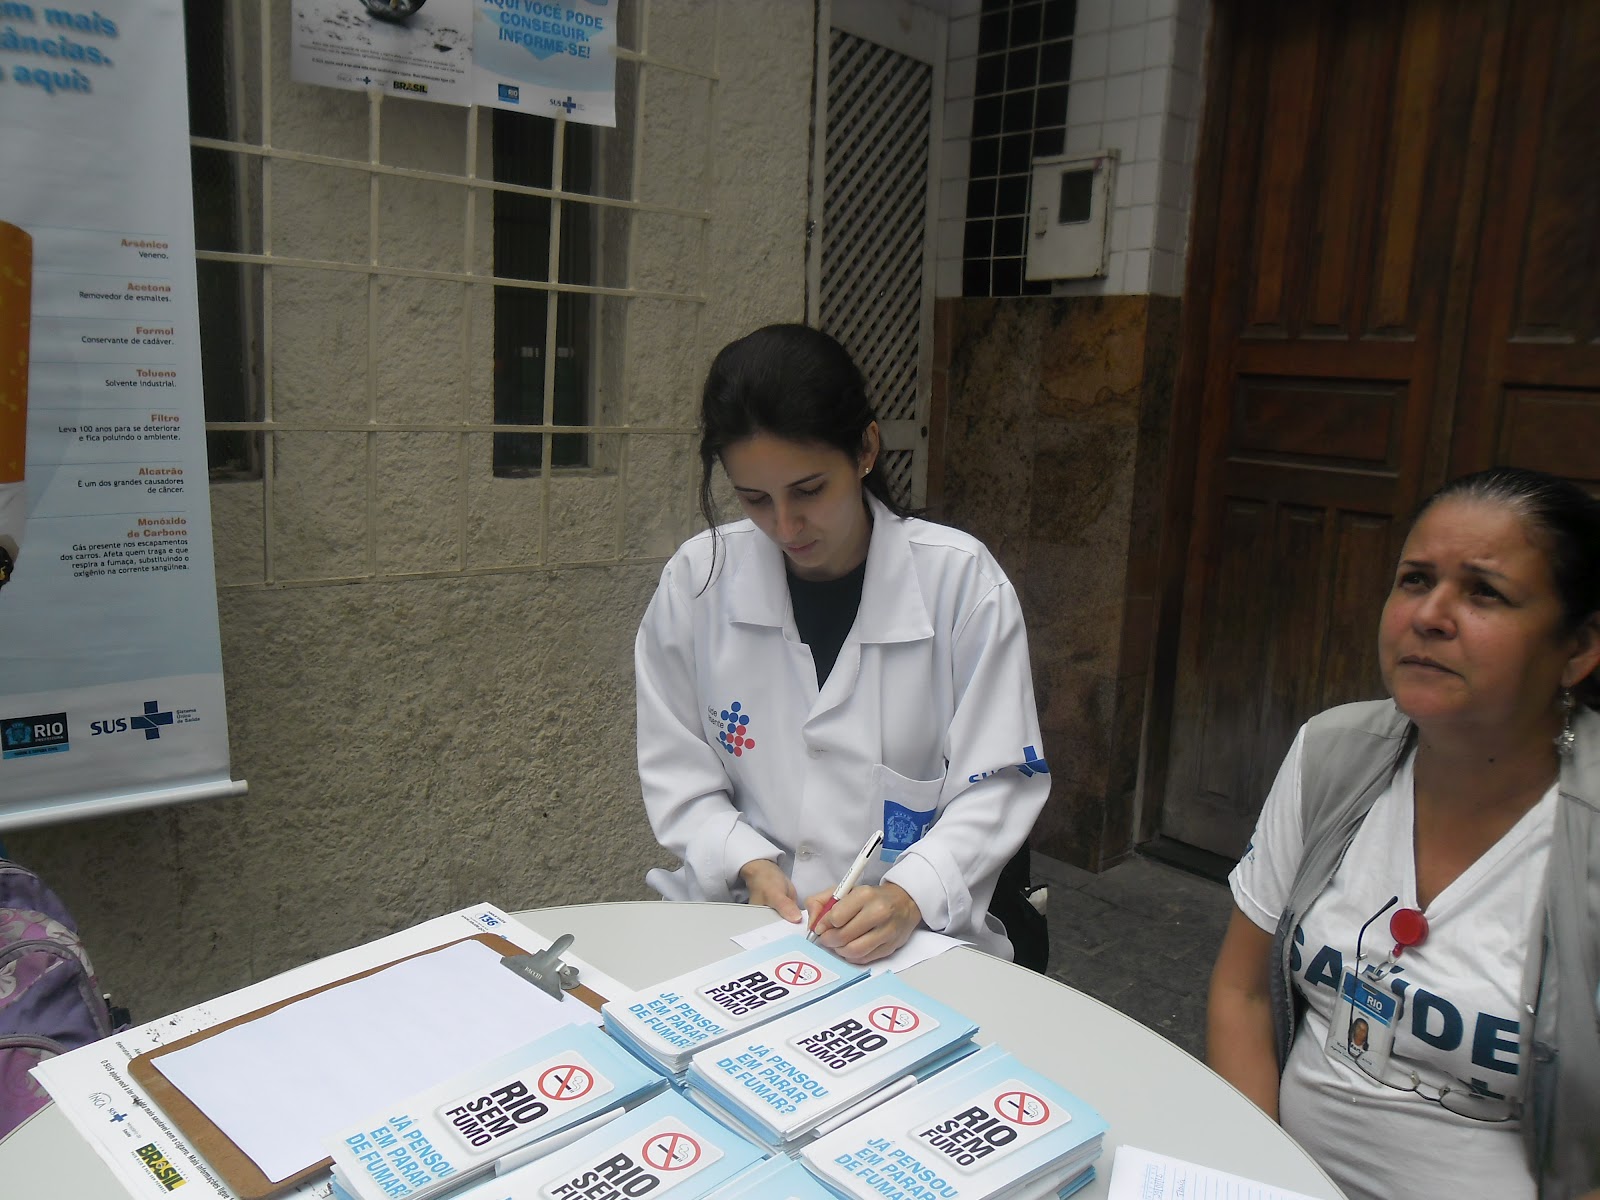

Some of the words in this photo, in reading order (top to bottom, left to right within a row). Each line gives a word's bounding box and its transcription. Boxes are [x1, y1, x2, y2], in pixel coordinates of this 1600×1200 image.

[44, 8, 118, 38] mais
[500, 11, 589, 42] CONSEGUIR.
[565, 10, 604, 30] PODE
[498, 28, 591, 59] INFORME-SE!
[393, 80, 428, 93] BRASIL
[121, 238, 168, 249] Arsênico
[139, 251, 169, 259] Veneno.
[79, 292, 121, 300] Removedor
[124, 293, 134, 301] de
[136, 294, 171, 302] esmaltes.
[127, 283, 171, 292] Acetona
[81, 336, 128, 344] Conservante
[131, 337, 141, 345] de
[142, 337, 174, 345] cadáver.
[136, 327, 174, 336] Formol
[136, 369, 176, 378] Tolueno
[151, 414, 179, 422] Filtro
[102, 434, 135, 443] poluindo
[99, 479, 111, 487] dos
[114, 479, 142, 488] grandes
[138, 467, 183, 476] Alcatrão
[147, 486, 157, 494] de
[127, 530, 140, 538] de
[143, 529, 187, 537] Carbono
[138, 517, 186, 526] Monóxido
[60, 553, 74, 561] dos
[75, 552, 101, 560] carros.
[103, 550, 123, 558] Afeta
[125, 549, 146, 558] quem
[148, 547, 167, 556] traga
[175, 547, 189, 555] que
[72, 543, 87, 552] Gás
[88, 541, 121, 551] presente
[137, 538, 188, 548] escapamentos
[72, 560, 98, 570] respira
[107, 557, 137, 567] fumaça,
[138, 555, 183, 565] substituindo
[73, 567, 105, 578] oxigênio
[118, 566, 150, 574] corrente
[34, 722, 64, 738] RIO
[90, 717, 127, 736] SUS
[479, 914, 499, 926] 136
[721, 981, 768, 1010] SEM
[737, 971, 790, 1001] RIO
[660, 992, 684, 1004] JÁ
[677, 1002, 728, 1036] PENSOU
[704, 987, 749, 1017] FUMO
[1366, 995, 1383, 1010] RIO
[628, 1003, 645, 1020] DE
[644, 1015, 700, 1049] FUMAR?
[647, 1000, 665, 1013] EM
[665, 1011, 709, 1042] PARAR
[813, 1030, 867, 1063] SEM
[829, 1018, 888, 1052] RIO
[796, 1038, 848, 1070] FUMO
[735, 1053, 757, 1069] EM
[756, 1065, 808, 1105] PARAR
[748, 1044, 774, 1058] JÁ
[767, 1054, 828, 1098] PENSOU
[716, 1057, 736, 1075] DE
[735, 1070, 798, 1116] FUMAR?
[489, 1080, 549, 1125] RIO
[444, 1105, 493, 1148] FUMO
[466, 1095, 518, 1138] SEM
[953, 1105, 1018, 1147] RIO
[103, 1063, 114, 1072] SUS
[109, 1071, 121, 1081] ajuda
[118, 1080, 129, 1088] você
[144, 1108, 155, 1117] mais
[151, 1115, 170, 1131] saudável
[165, 1130, 176, 1140] sem
[174, 1141, 190, 1156] cigarro.
[187, 1154, 200, 1166] Mais
[196, 1163, 221, 1189] informações
[217, 1186, 230, 1199] ligue
[935, 1120, 996, 1159] SEM
[345, 1133, 372, 1158] DE
[369, 1125, 397, 1149] EM
[387, 1145, 432, 1189] PARAR
[388, 1114, 418, 1131] JÁ
[404, 1127, 457, 1178] PENSOU
[854, 1148, 881, 1167] EM
[918, 1128, 976, 1167] FUMO
[135, 1143, 184, 1192] BRASIL
[593, 1152, 661, 1198] RIO
[834, 1153, 857, 1174] DE
[866, 1138, 896, 1153] JÁ
[888, 1148, 959, 1200] PENSOU
